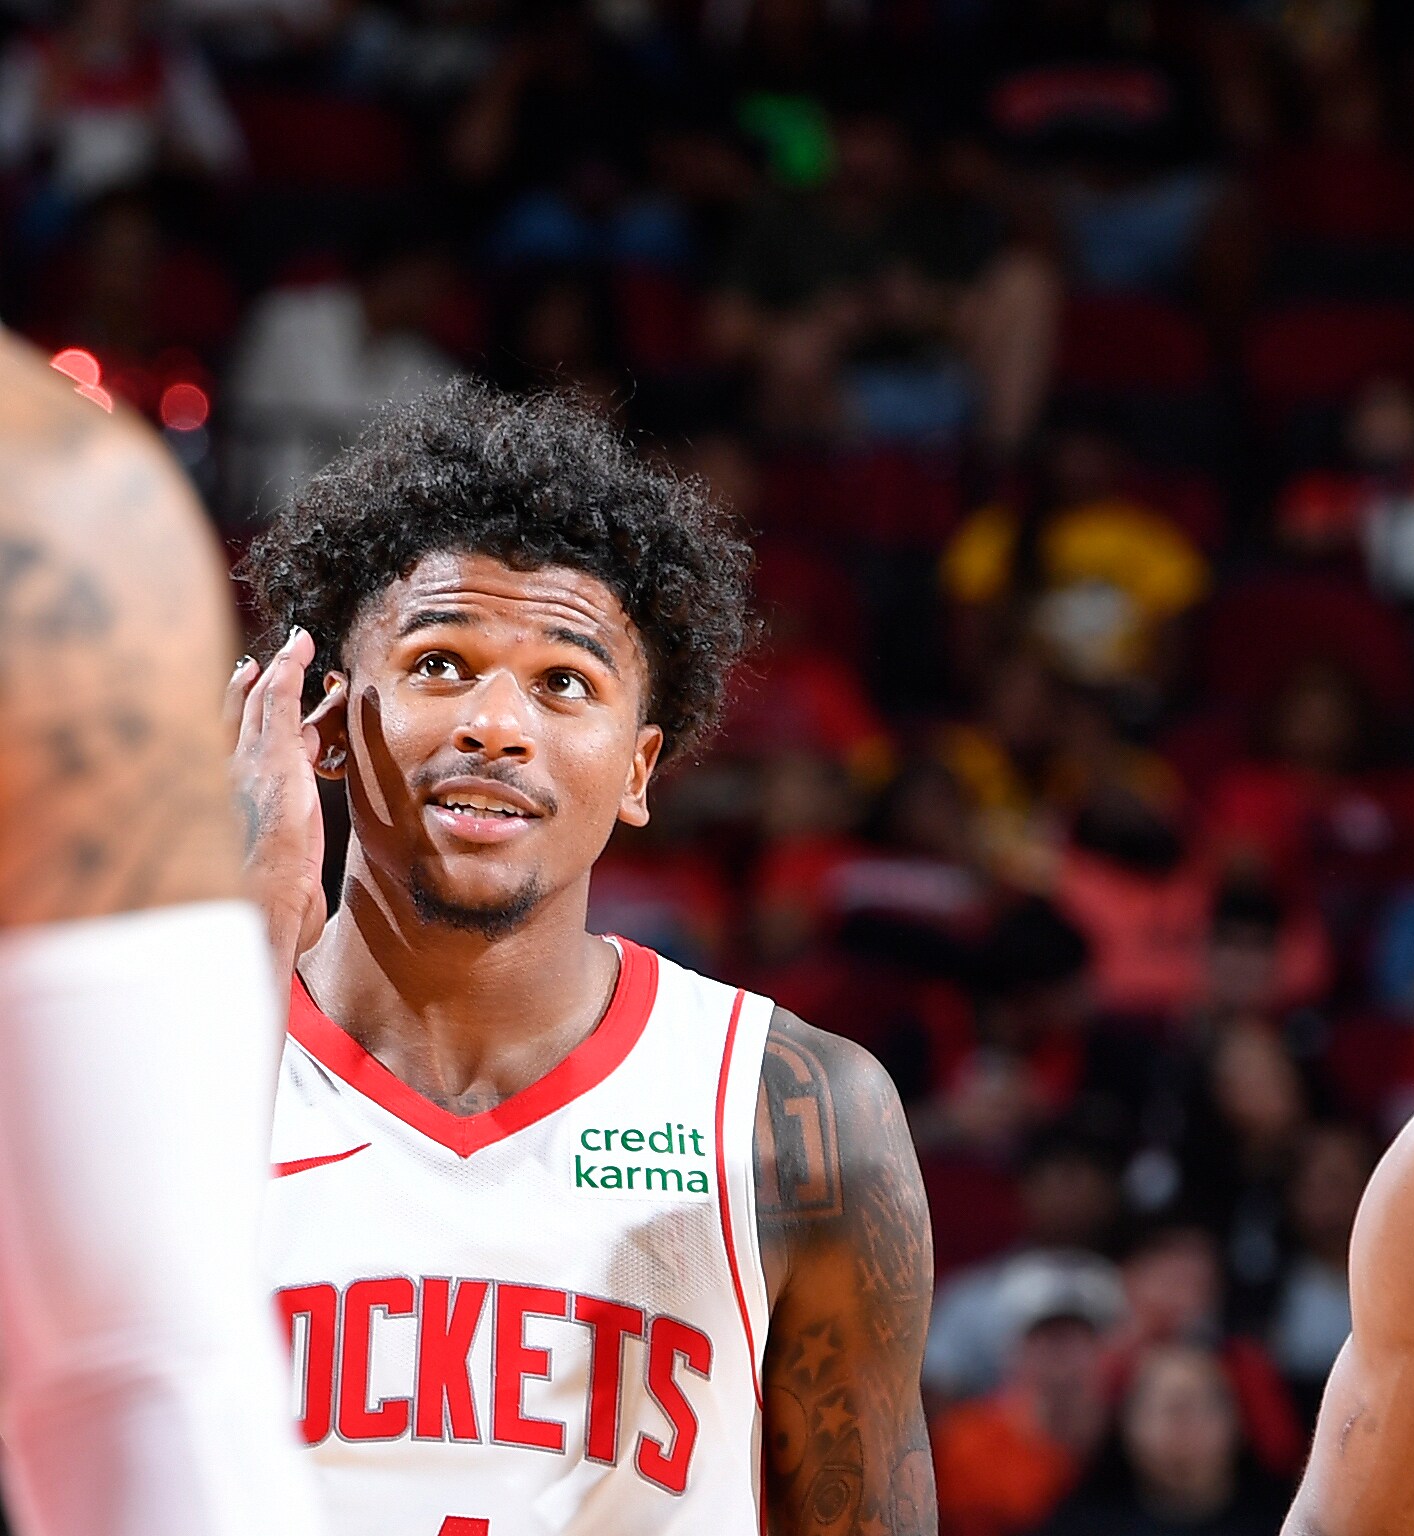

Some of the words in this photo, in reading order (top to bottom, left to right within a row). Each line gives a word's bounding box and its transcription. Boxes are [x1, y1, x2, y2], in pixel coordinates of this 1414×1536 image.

[579, 1121, 706, 1158] credit
[574, 1153, 710, 1195] karma
[272, 1274, 715, 1497] OCKETS
